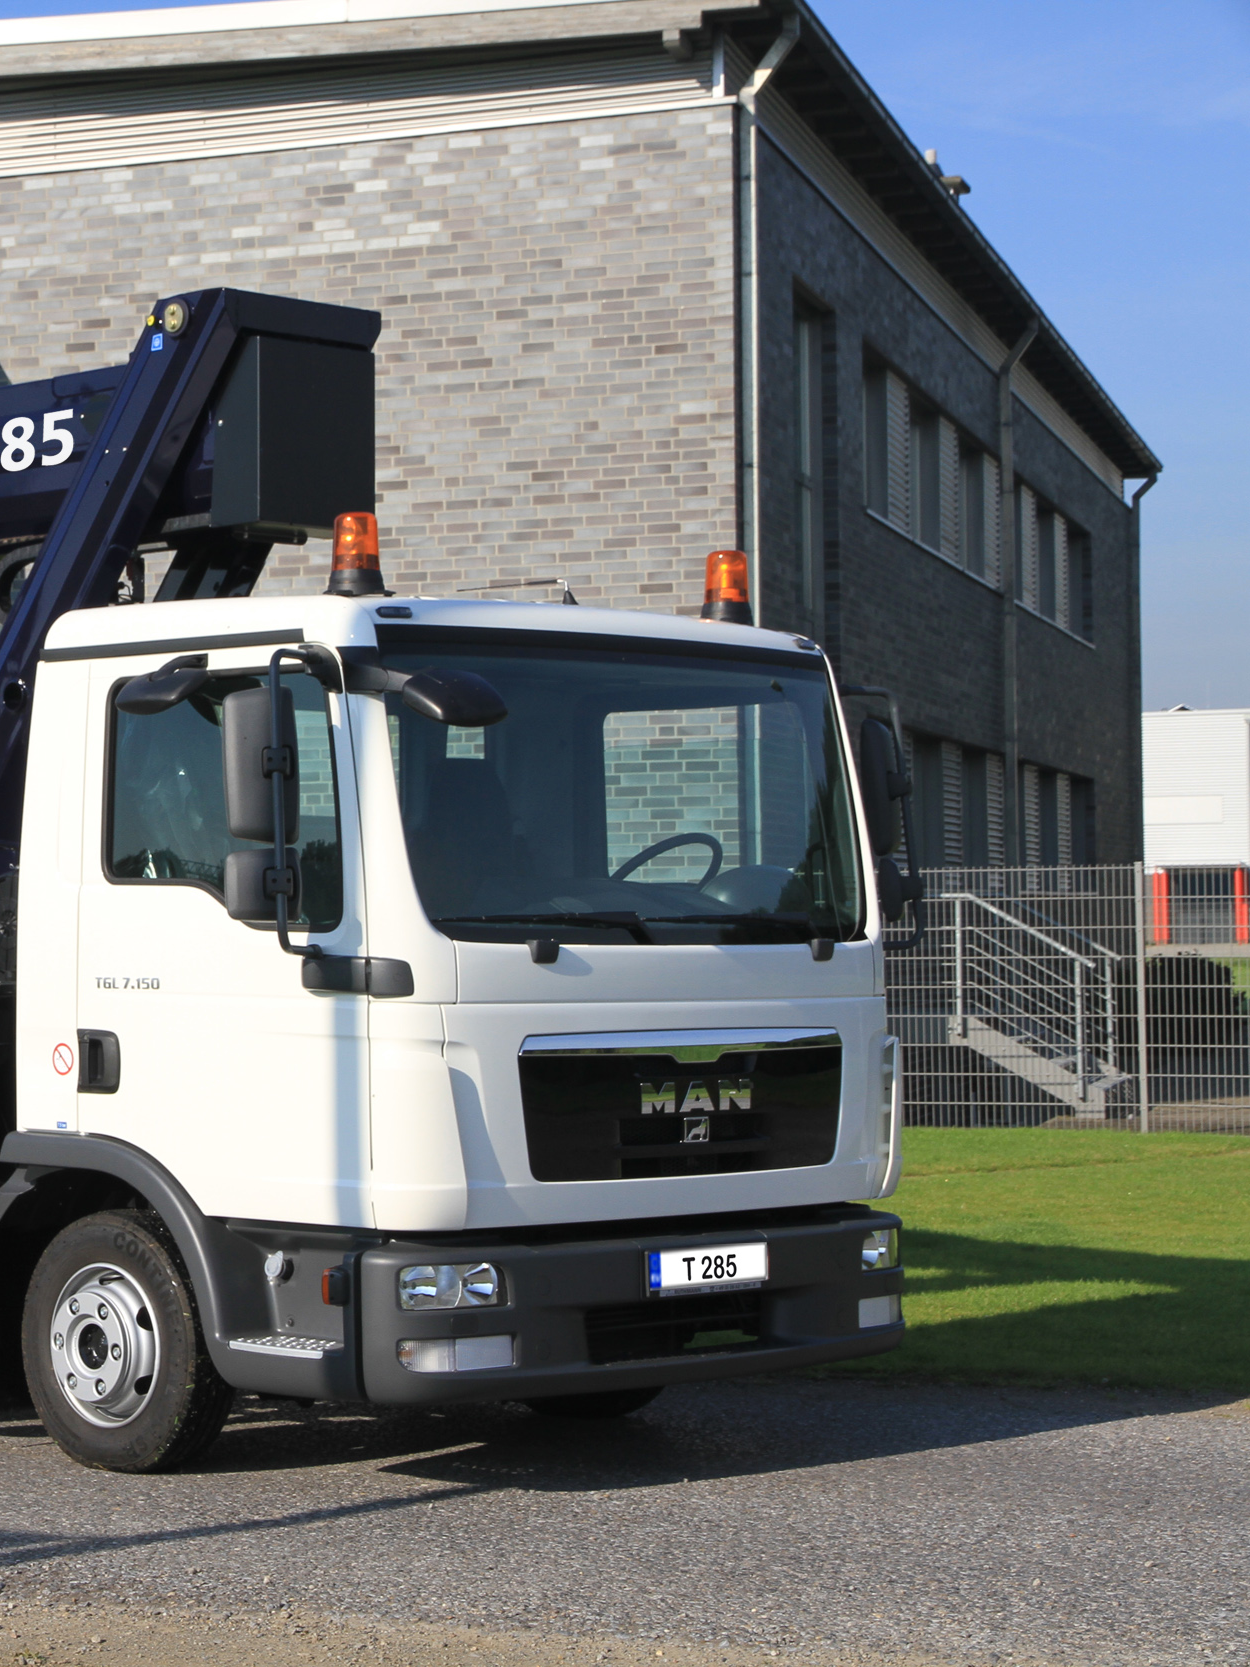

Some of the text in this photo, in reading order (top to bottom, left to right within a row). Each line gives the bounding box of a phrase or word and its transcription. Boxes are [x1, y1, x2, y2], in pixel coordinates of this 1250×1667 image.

[95, 977, 161, 990] TGL 7.150
[640, 1079, 752, 1114] MAN
[682, 1254, 737, 1281] T 285
